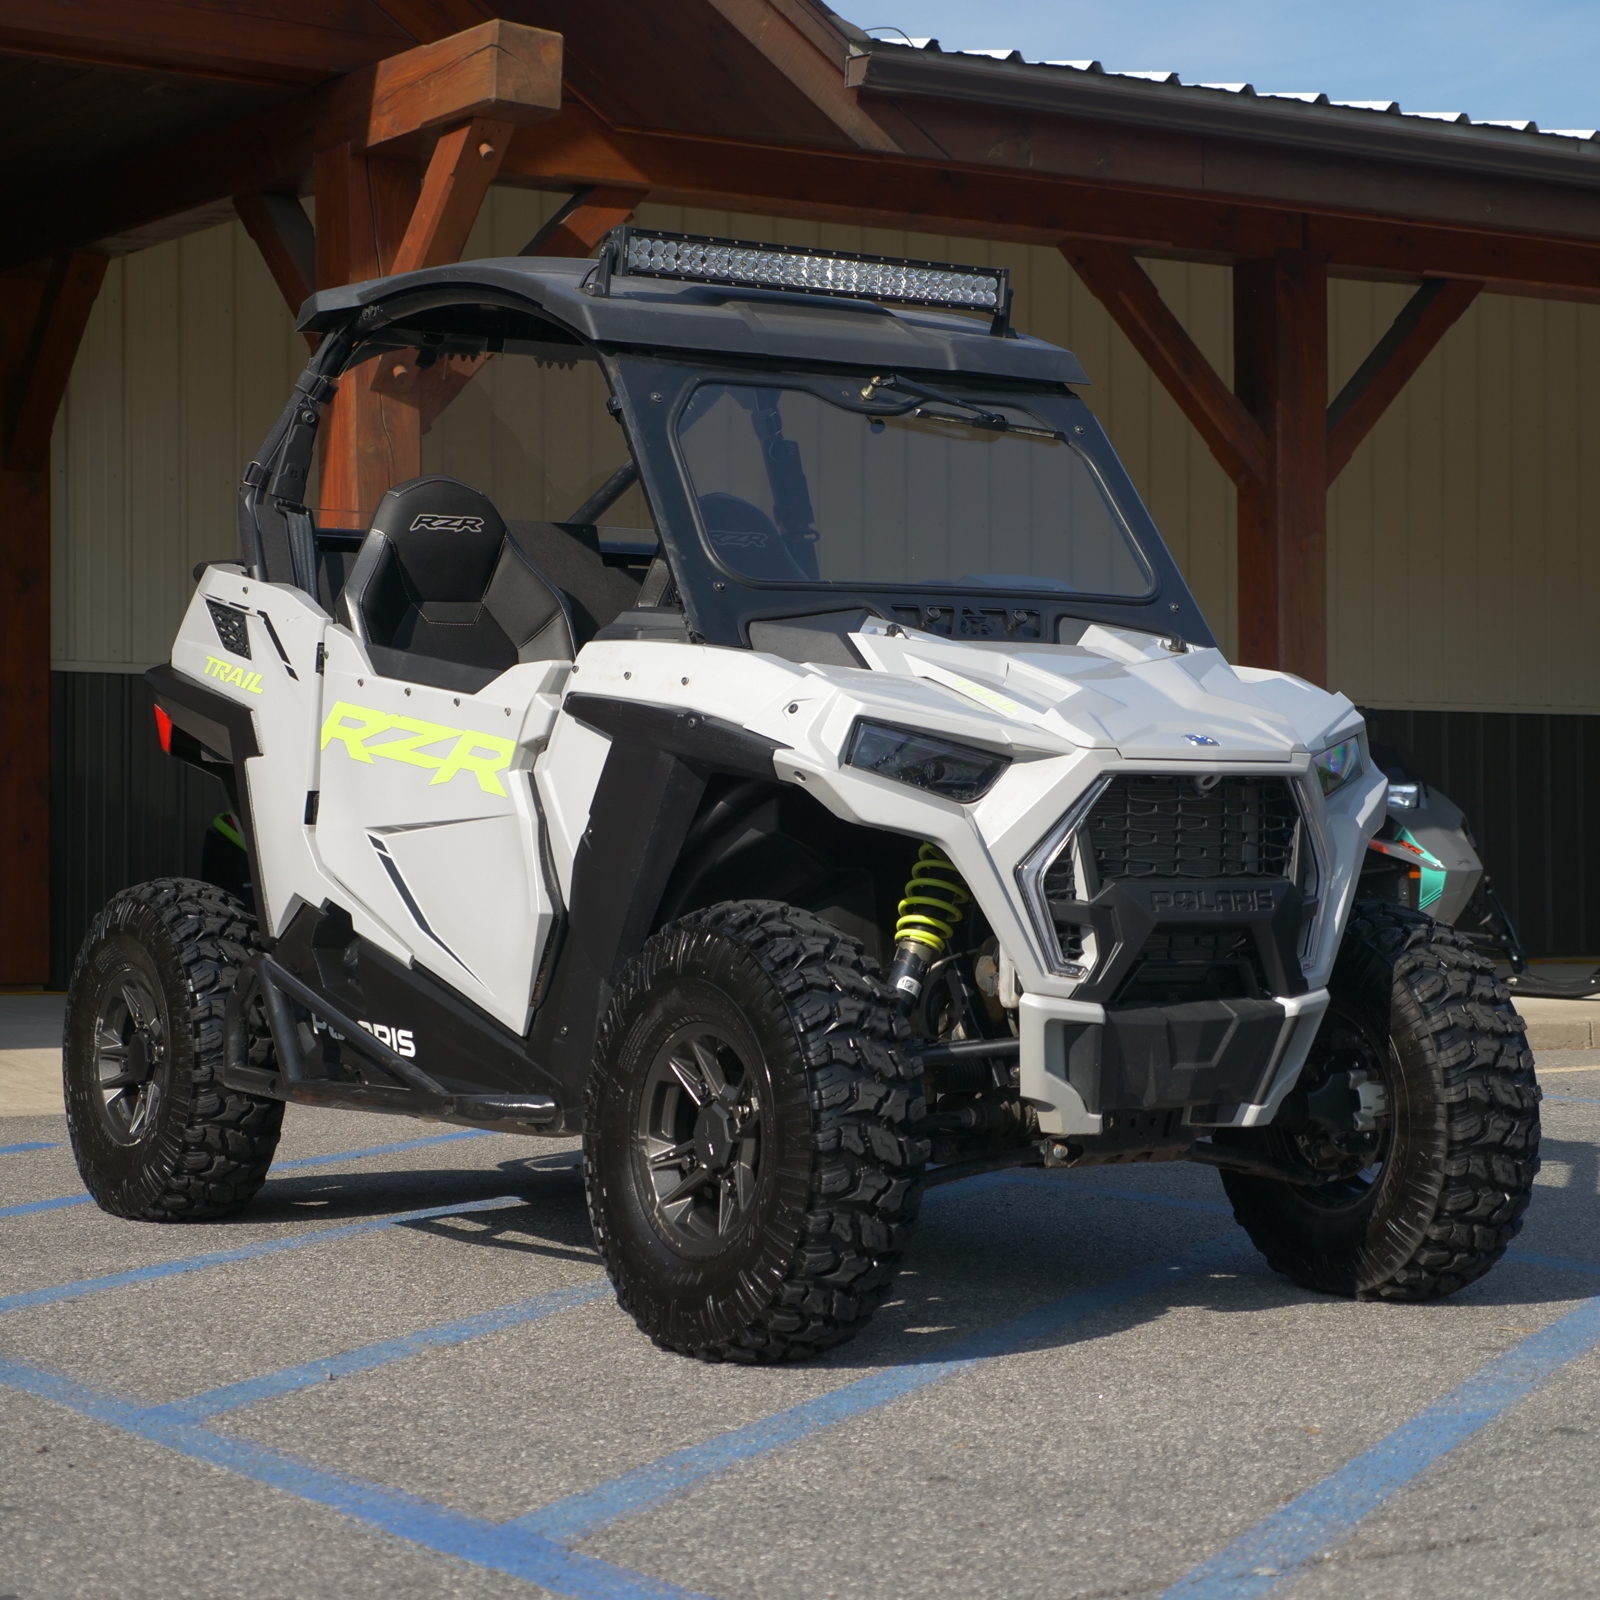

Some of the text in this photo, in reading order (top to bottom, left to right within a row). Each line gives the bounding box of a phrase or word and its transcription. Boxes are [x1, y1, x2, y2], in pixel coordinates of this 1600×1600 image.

[409, 513, 485, 533] RZR
[203, 654, 264, 695] TRAIL
[953, 679, 1018, 714] TRAIL
[320, 700, 518, 798] RZR
[1150, 890, 1275, 912] POLARIS
